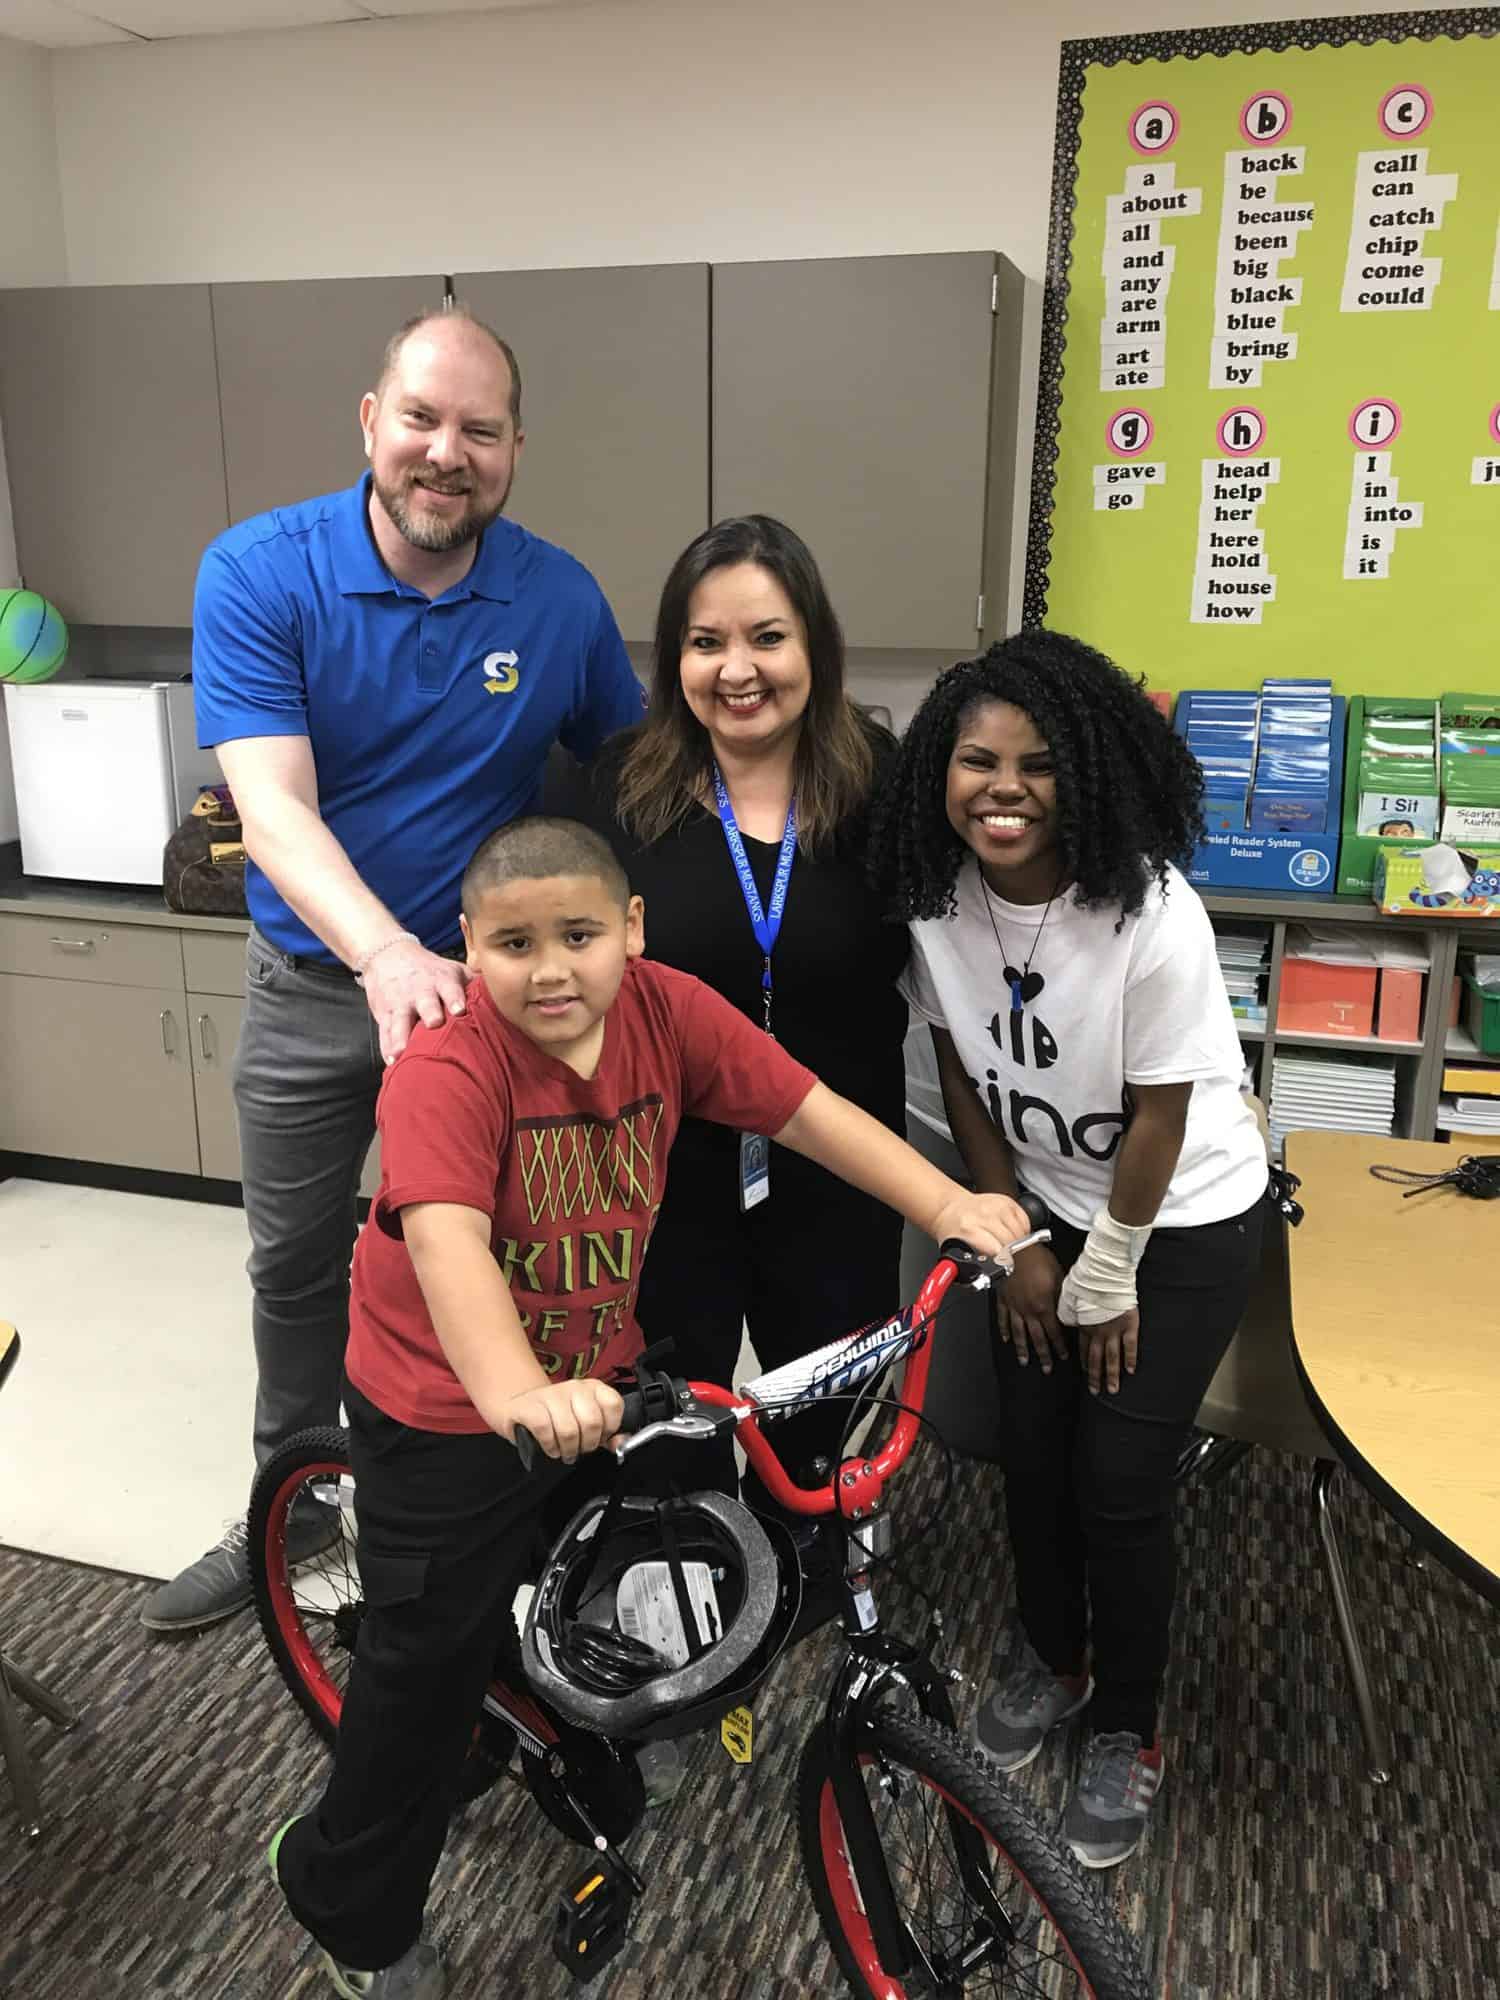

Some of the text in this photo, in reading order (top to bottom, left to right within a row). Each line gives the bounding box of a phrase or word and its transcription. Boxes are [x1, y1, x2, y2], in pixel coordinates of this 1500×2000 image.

[1257, 102, 1277, 135] b
[1397, 102, 1413, 123] c
[1145, 118, 1163, 140] a
[1241, 153, 1298, 174] back
[1373, 154, 1418, 174] call
[1142, 173, 1155, 187] a
[1239, 183, 1267, 201] be
[1371, 182, 1414, 197] can
[1122, 193, 1188, 214] about
[1237, 208, 1315, 225] because
[1369, 207, 1435, 228] catch
[1122, 224, 1150, 243] all
[1234, 234, 1288, 251] been
[1365, 237, 1419, 257] chip
[1123, 251, 1164, 269] and
[1233, 259, 1269, 279] big
[1361, 264, 1424, 280] come
[1120, 277, 1161, 294] any
[1230, 285, 1294, 304] black
[1357, 287, 1425, 306] could
[1121, 298, 1157, 313] are
[1116, 319, 1161, 334] arm
[1227, 313, 1276, 330] blue
[1116, 349, 1150, 365] art
[1227, 339, 1289, 359] bring
[1115, 370, 1149, 386] ate
[1225, 365, 1253, 384] by
[1121, 417, 1140, 448] g
[1233, 415, 1251, 446] h
[1369, 411, 1380, 437] i
[1217, 461, 1270, 479] head
[1366, 456, 1377, 473] I
[1106, 466, 1156, 483] gave
[1213, 483, 1262, 502] help
[1364, 482, 1387, 498] in
[1107, 494, 1133, 510] go
[1214, 506, 1253, 522] her
[1364, 507, 1413, 522] into
[1209, 532, 1259, 548] here
[1361, 534, 1381, 550] is
[1211, 553, 1260, 568] hold
[1359, 558, 1378, 574] it
[1207, 579, 1272, 595] house
[1206, 602, 1255, 618] how
[1381, 797, 1419, 813] I Sit
[1231, 836, 1266, 847] Reader
[1267, 838, 1302, 849] System
[1230, 847, 1263, 859] Deluxe
[500, 1228, 636, 1293] KIN
